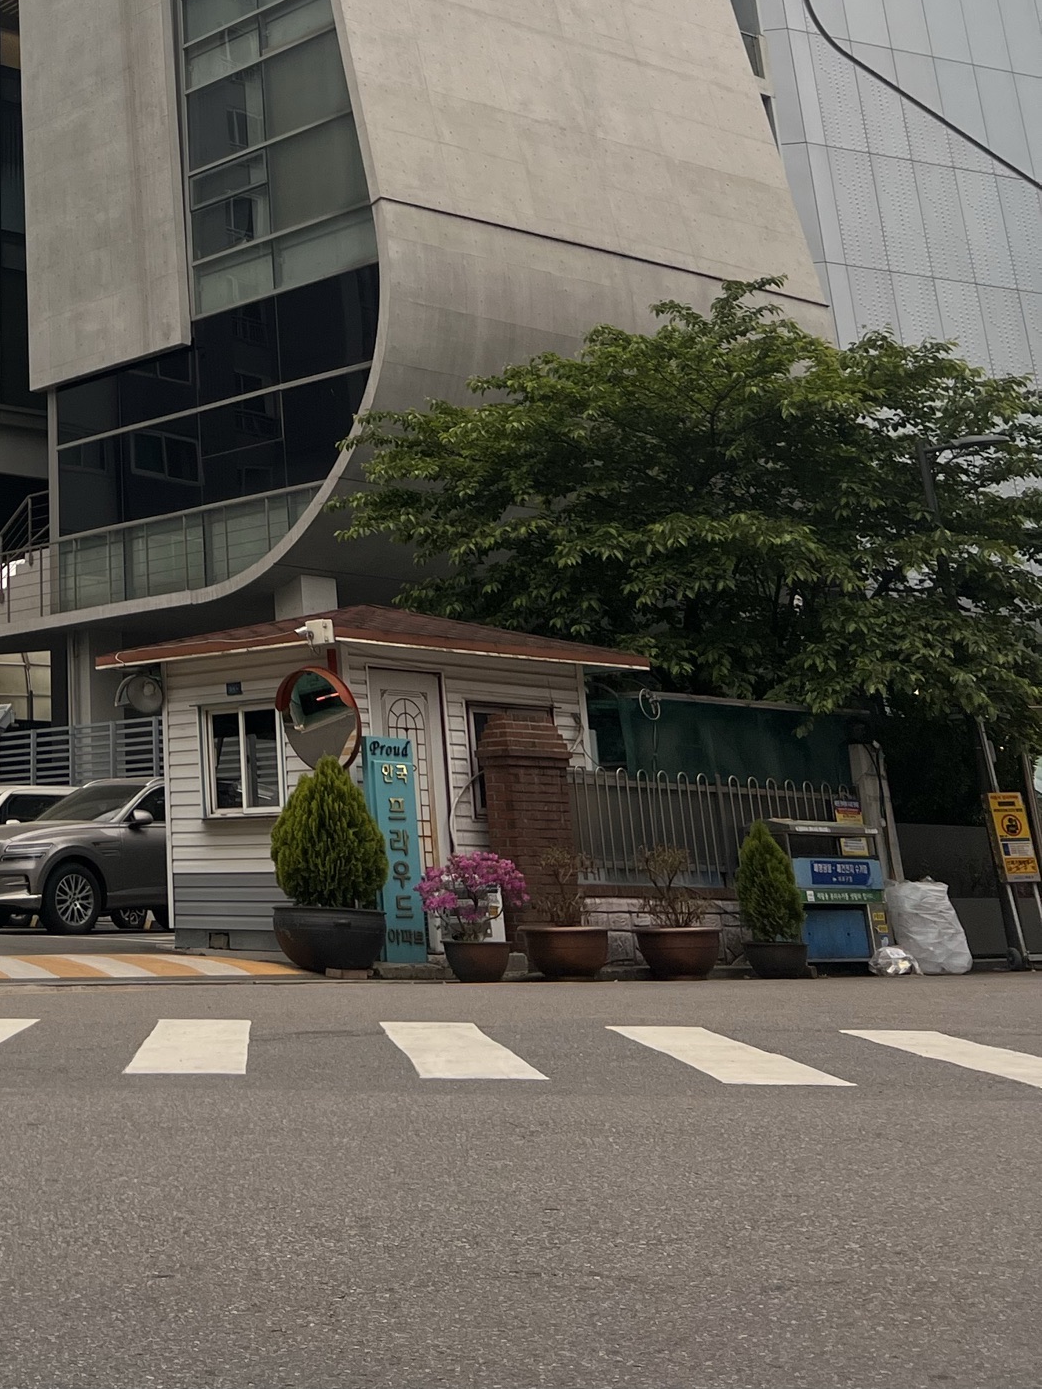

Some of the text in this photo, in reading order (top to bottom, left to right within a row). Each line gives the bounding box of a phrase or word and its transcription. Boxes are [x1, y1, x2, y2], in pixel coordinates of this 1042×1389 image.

[369, 740, 410, 757] Proud
[388, 797, 414, 918] 프라우드
[388, 928, 425, 946] 아파트
